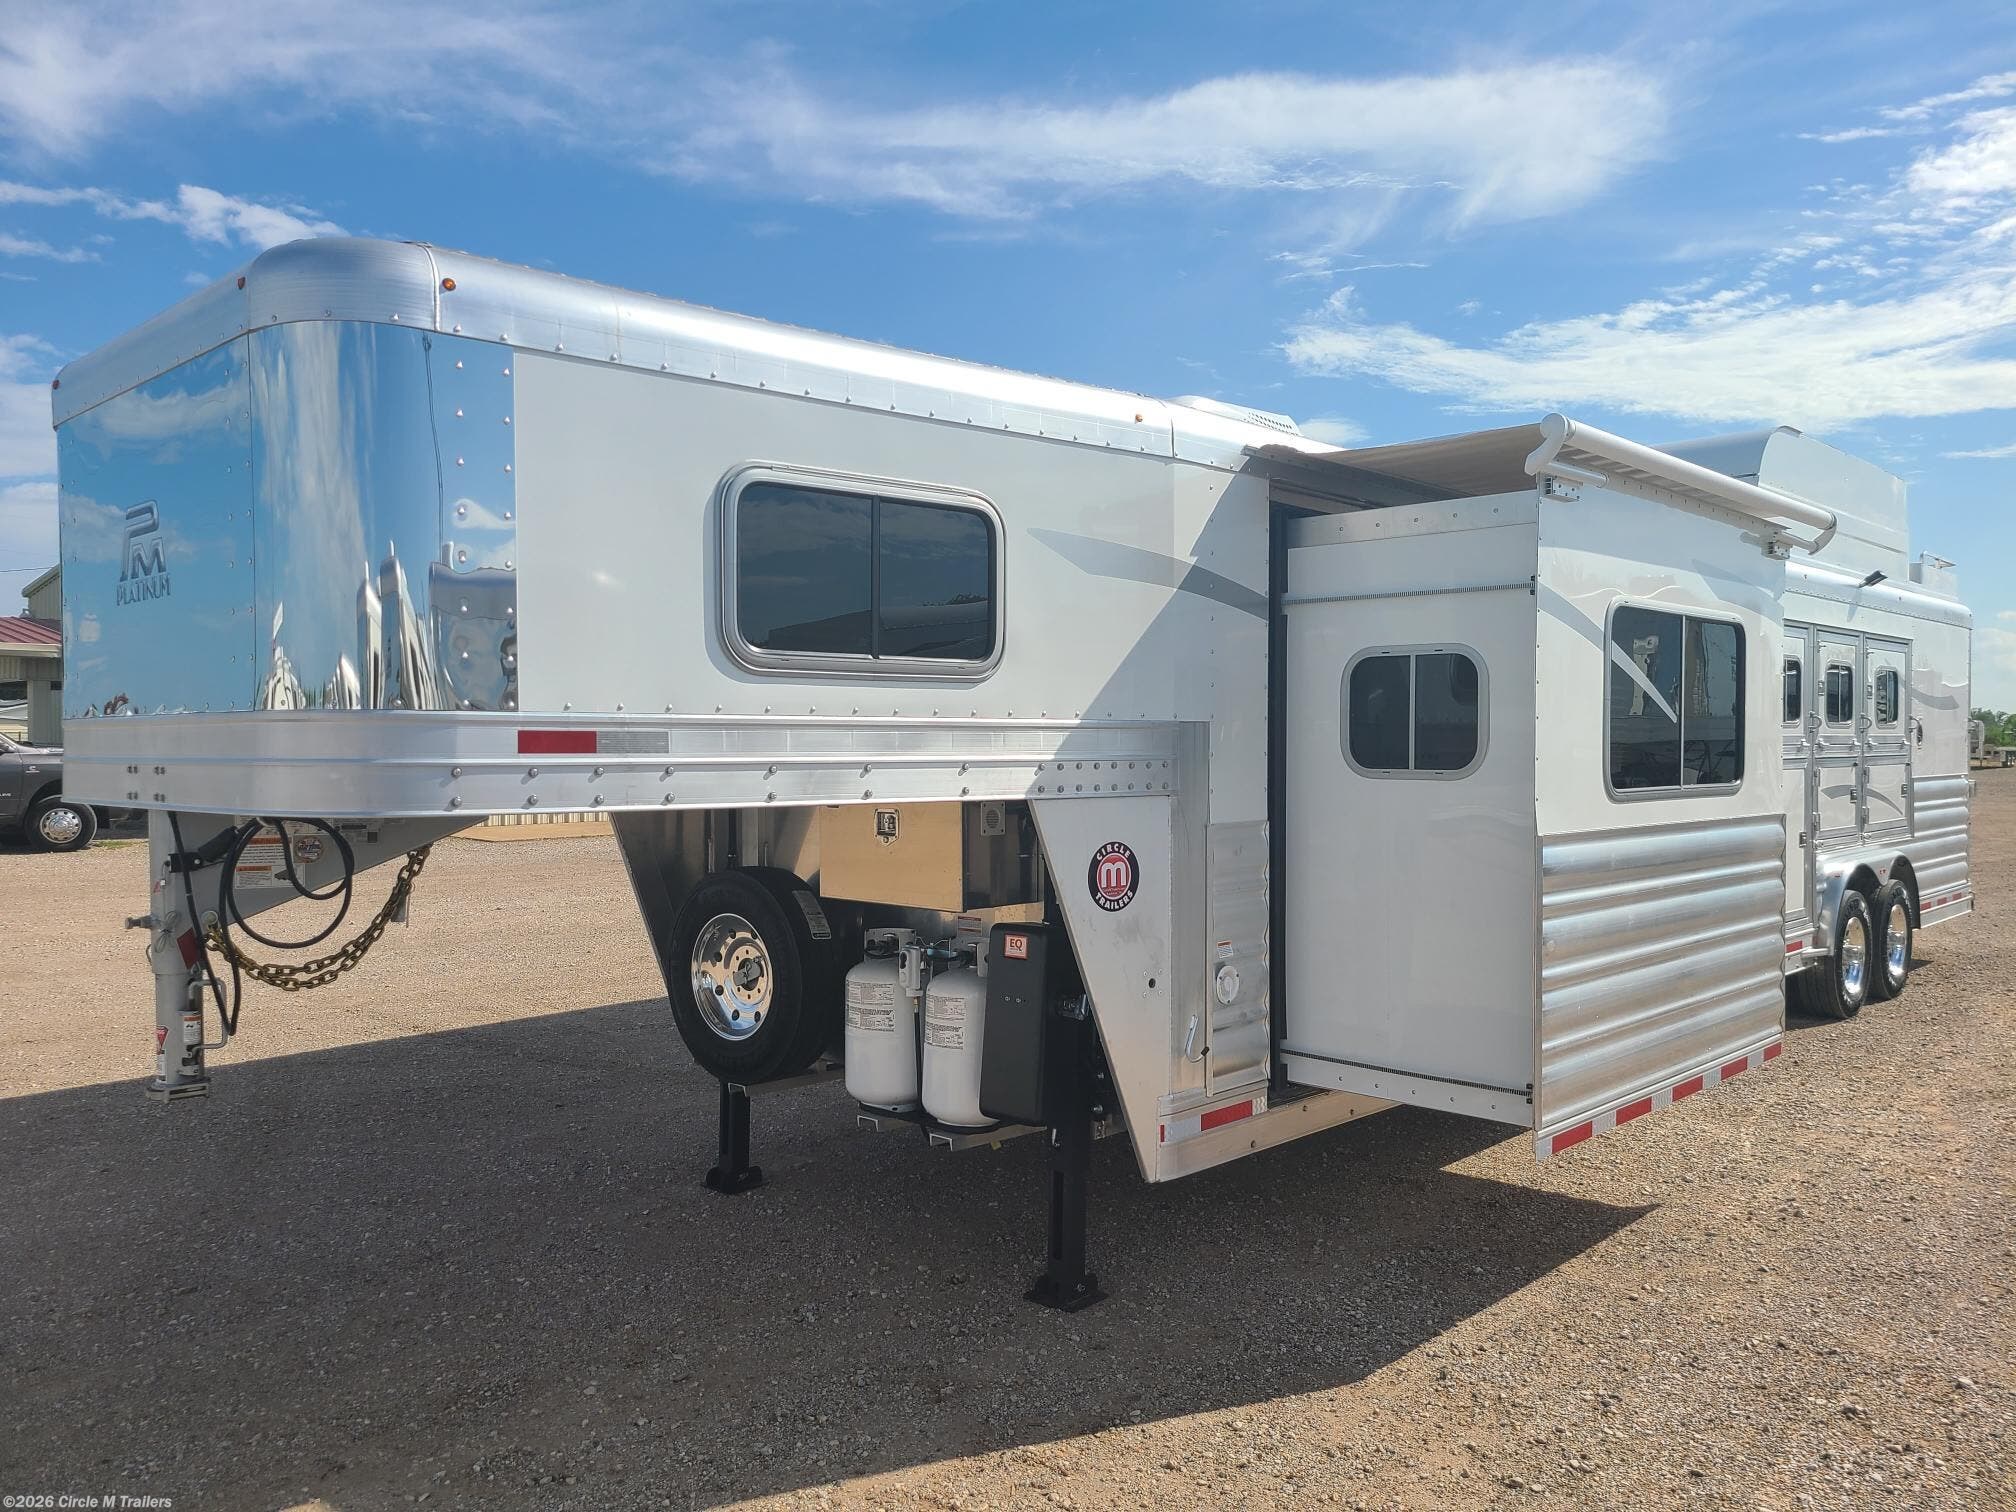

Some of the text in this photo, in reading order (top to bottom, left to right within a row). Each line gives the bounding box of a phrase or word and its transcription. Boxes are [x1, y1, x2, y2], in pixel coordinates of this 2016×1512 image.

[116, 574, 171, 606] PLATINUM
[1096, 843, 1131, 861] CIRCLE
[1095, 889, 1133, 910] TRAILERS
[1009, 938, 1023, 951] EQ
